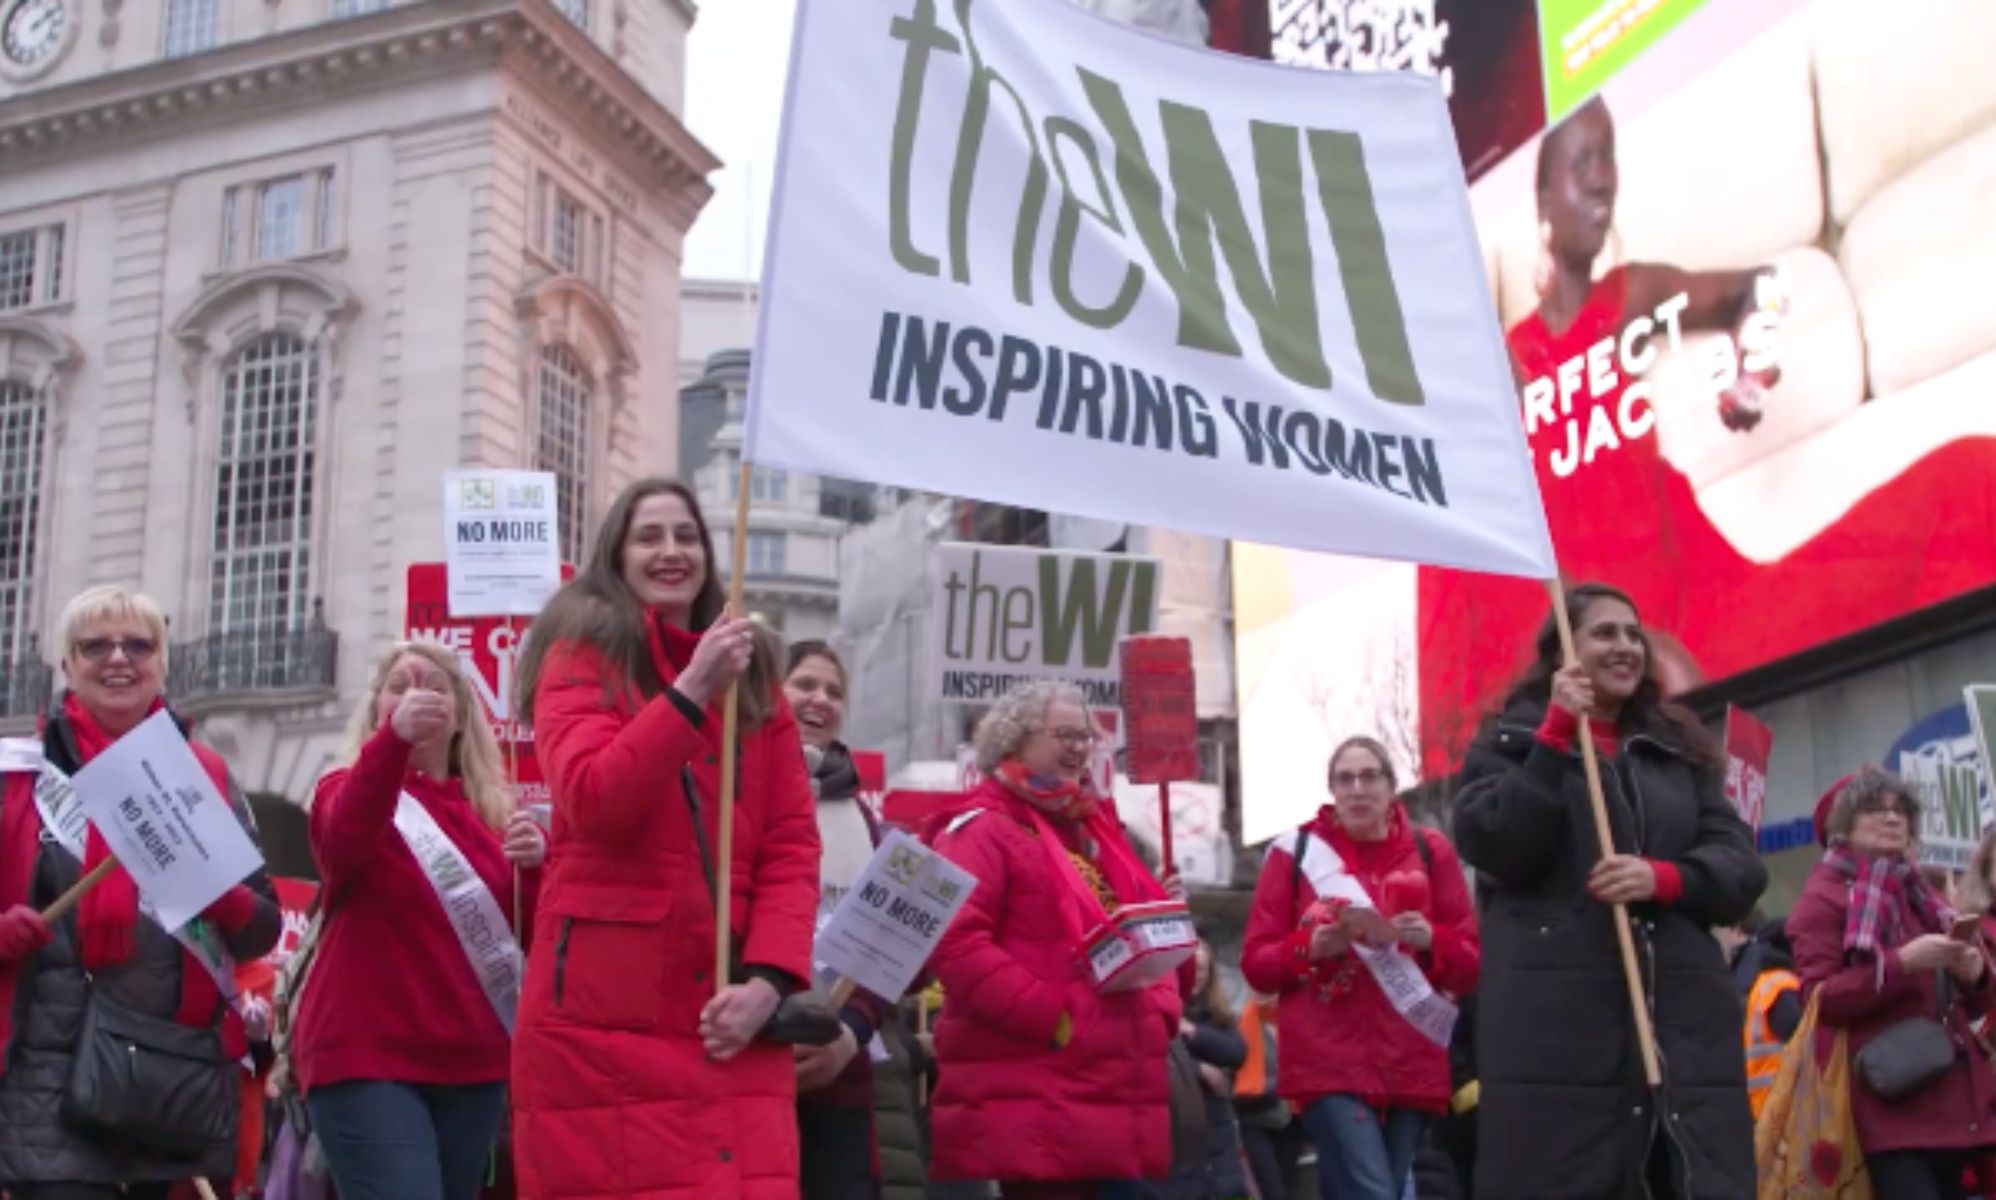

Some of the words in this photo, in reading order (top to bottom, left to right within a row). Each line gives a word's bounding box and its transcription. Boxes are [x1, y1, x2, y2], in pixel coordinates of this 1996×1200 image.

[889, 0, 1425, 406] theWI
[870, 311, 1218, 459] INSPIRING
[1222, 397, 1449, 508] WOMEN
[1524, 291, 1689, 434] RFECT
[457, 521, 485, 543] NO
[490, 521, 549, 543] MORE
[943, 550, 1156, 668] theWI
[118, 795, 142, 823] NO
[142, 820, 177, 872] MORE
[860, 880, 891, 909] NO
[886, 896, 941, 939] MORE
